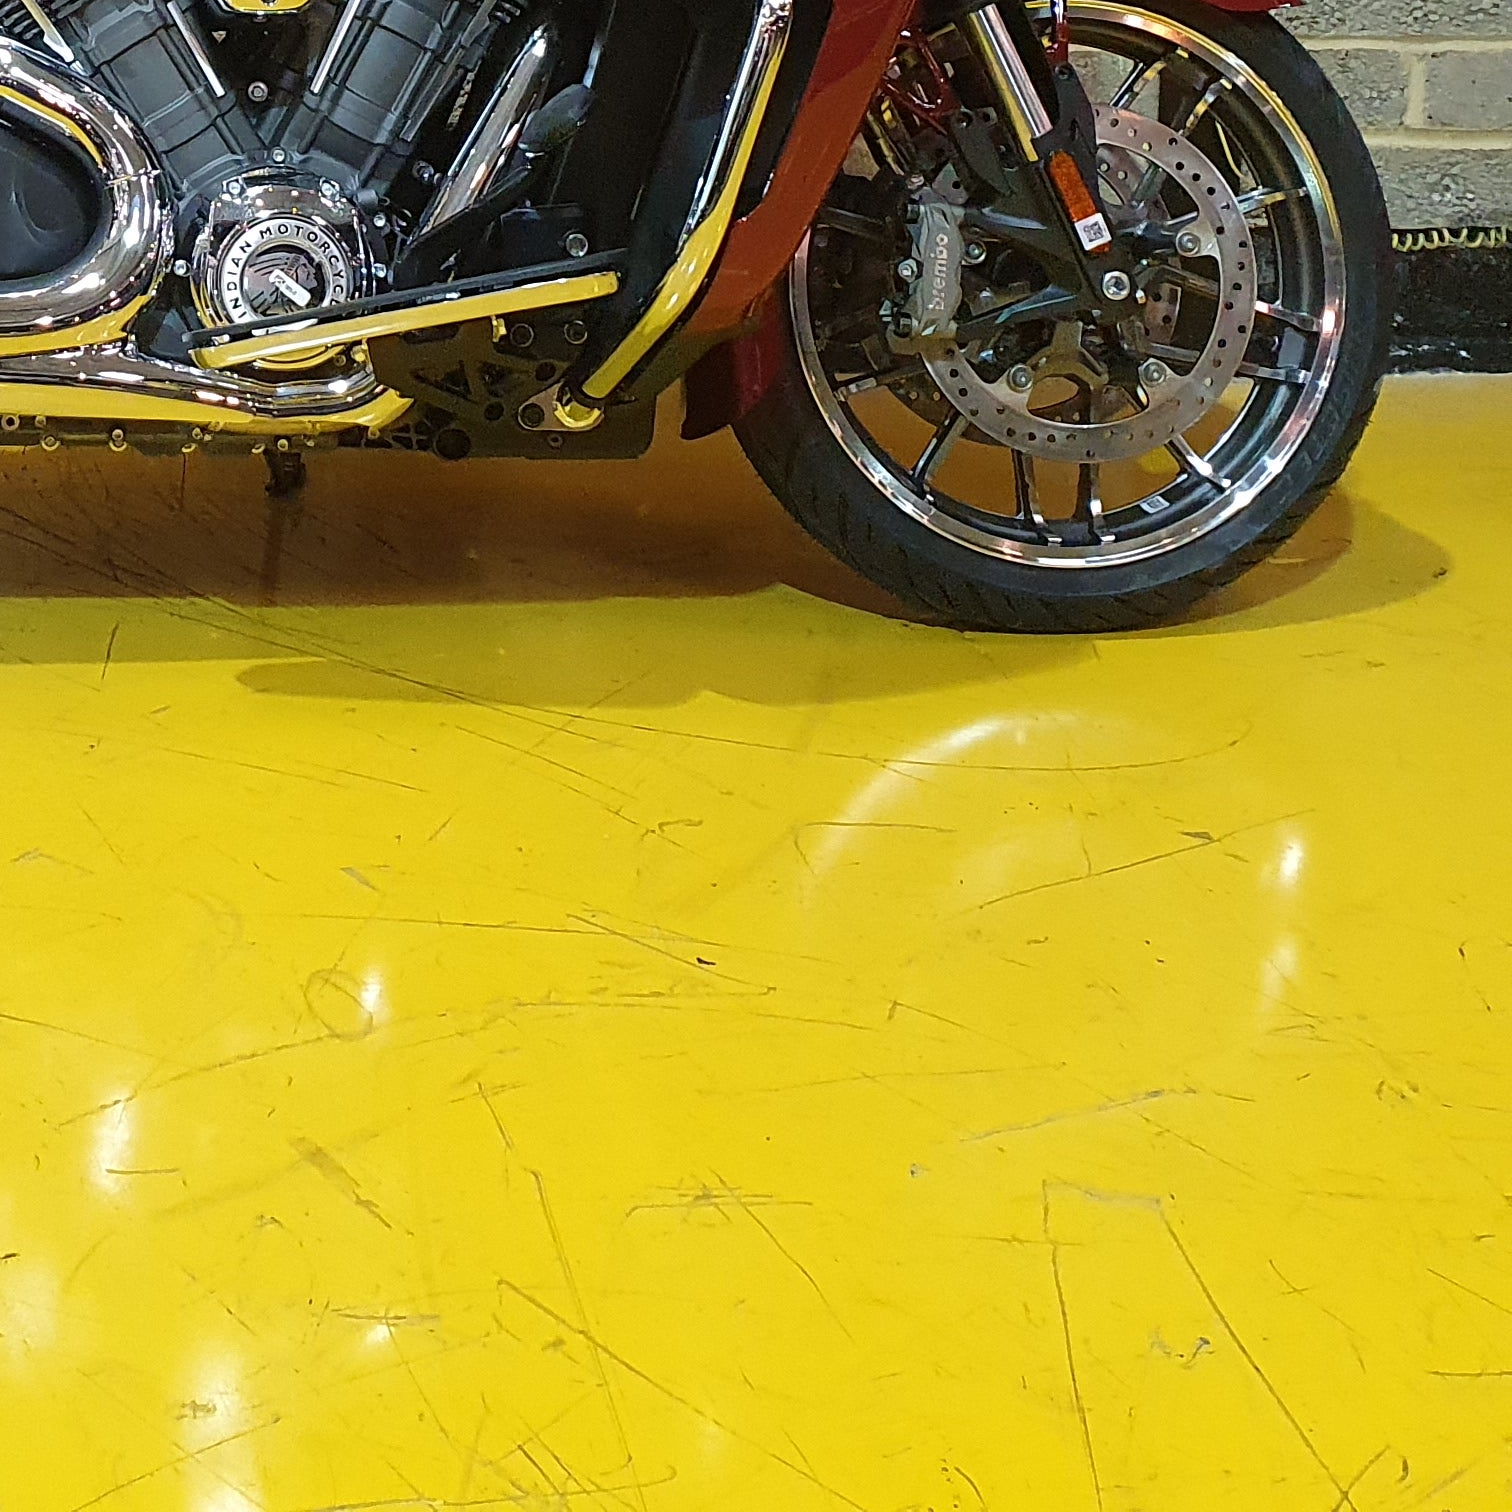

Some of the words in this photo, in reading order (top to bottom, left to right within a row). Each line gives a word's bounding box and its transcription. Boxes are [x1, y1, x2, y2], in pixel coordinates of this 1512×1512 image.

[226, 240, 253, 319] INDIAN
[259, 223, 345, 306] MOTORCYCL
[928, 233, 948, 310] brembo
